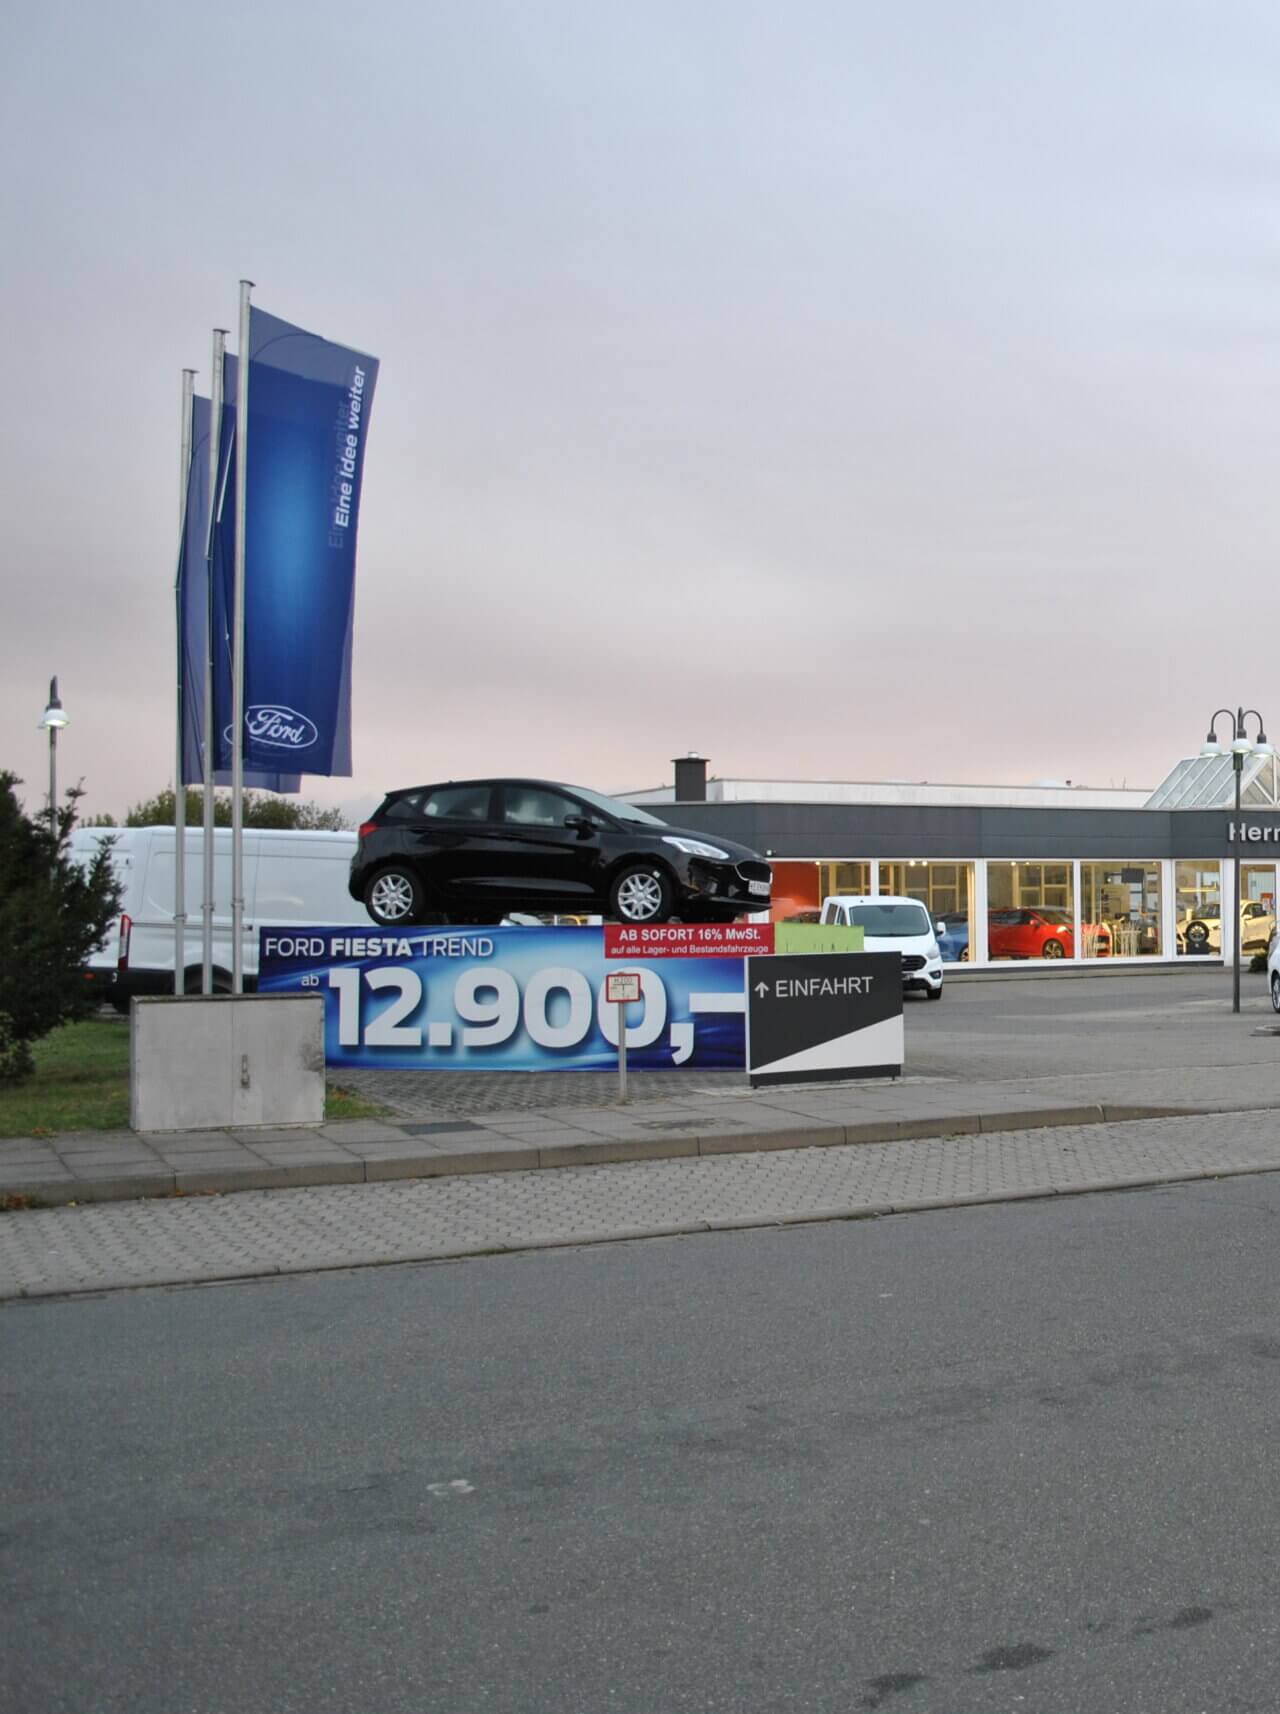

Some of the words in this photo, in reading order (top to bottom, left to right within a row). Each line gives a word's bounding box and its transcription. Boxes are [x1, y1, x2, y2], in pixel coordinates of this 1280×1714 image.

[347, 366, 366, 431] weiter
[341, 433, 358, 479] Idee
[336, 481, 353, 527] Eine
[249, 708, 305, 744] Ford
[619, 930, 638, 941] AB
[641, 929, 695, 941] SOFORT
[698, 928, 723, 941] 16%
[725, 928, 761, 940] MwSt.
[265, 938, 325, 957] FORD
[330, 938, 413, 957] FIESTA
[421, 938, 494, 957] TREND
[611, 945, 624, 954] auf
[626, 945, 641, 954] alle
[643, 945, 670, 956] Lager-
[671, 945, 688, 953] und
[689, 944, 769, 955] Bestandsfahrzeuge
[301, 974, 320, 987] ab
[775, 976, 874, 998] EINFAHRT
